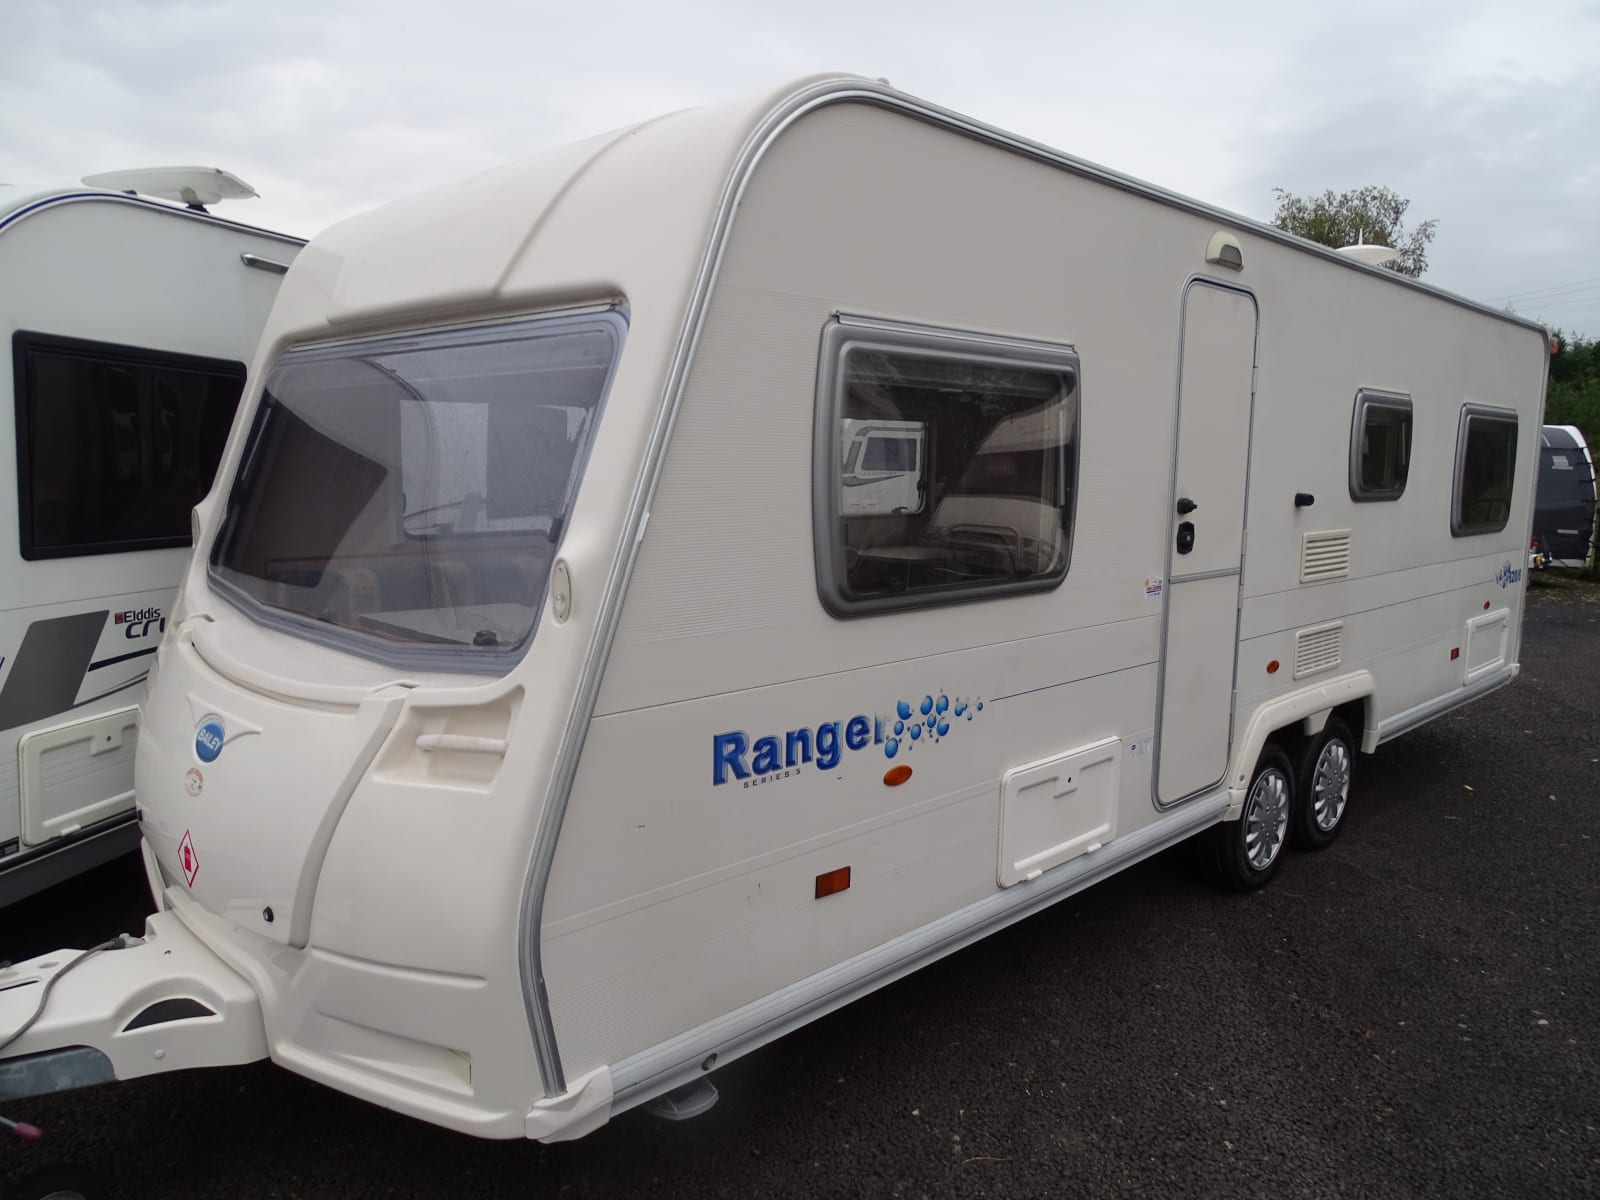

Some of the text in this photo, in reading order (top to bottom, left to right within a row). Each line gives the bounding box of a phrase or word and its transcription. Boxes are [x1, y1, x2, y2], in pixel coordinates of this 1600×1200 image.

[123, 607, 161, 623] Elddis
[712, 711, 888, 786] Ranger
[743, 770, 790, 789] SERIES
